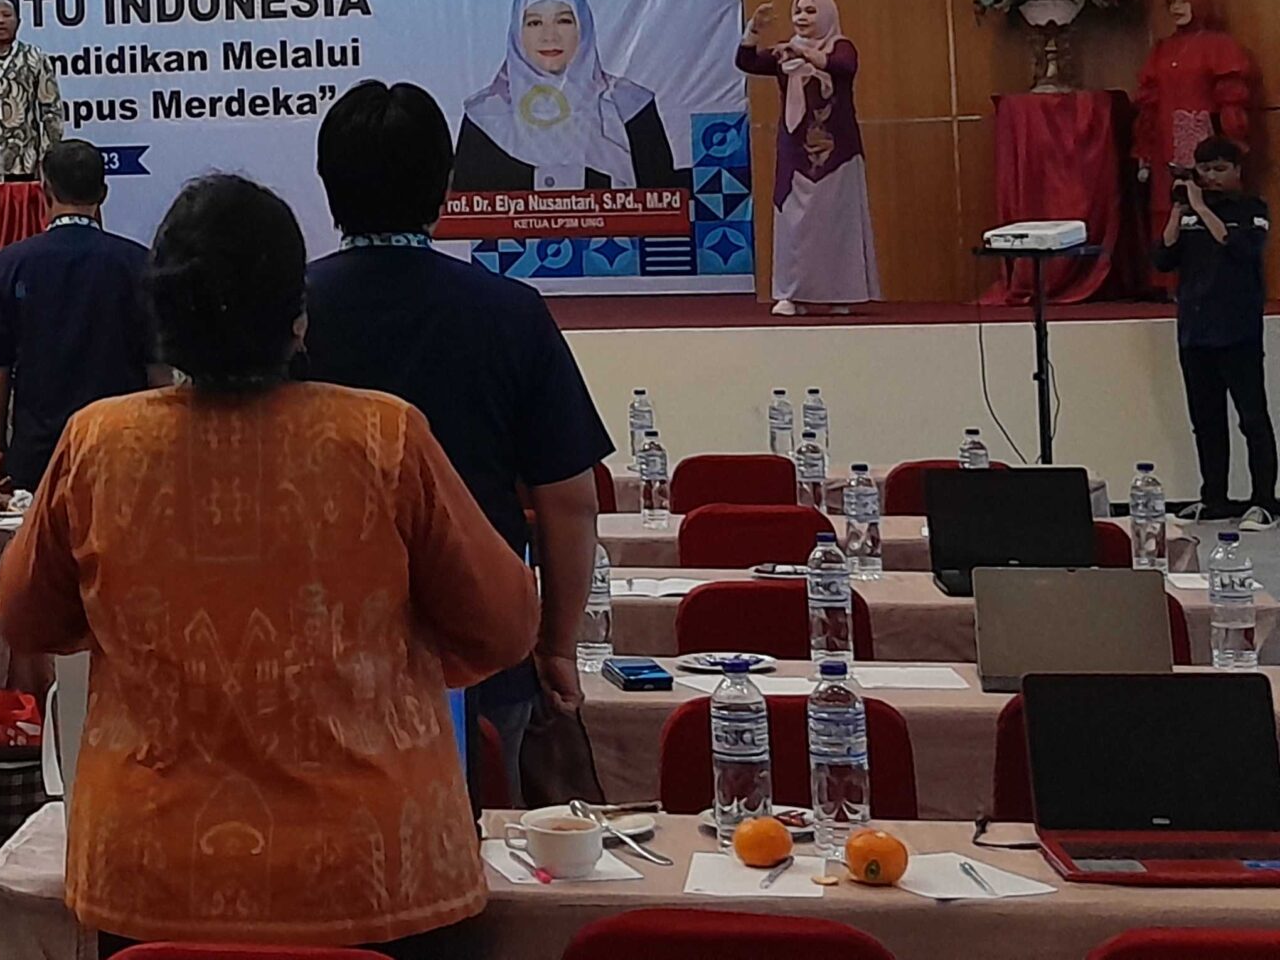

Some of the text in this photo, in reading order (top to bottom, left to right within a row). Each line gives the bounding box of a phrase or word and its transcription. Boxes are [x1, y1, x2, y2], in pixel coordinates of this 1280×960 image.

[223, 38, 360, 70] Melalui
[473, 195, 492, 212] Dr.
[495, 194, 525, 216] Elya
[528, 192, 600, 212] Nusantari,
[603, 192, 642, 212] S.Pd.,
[646, 191, 681, 209] M.Pd
[513, 219, 550, 229] KETUA
